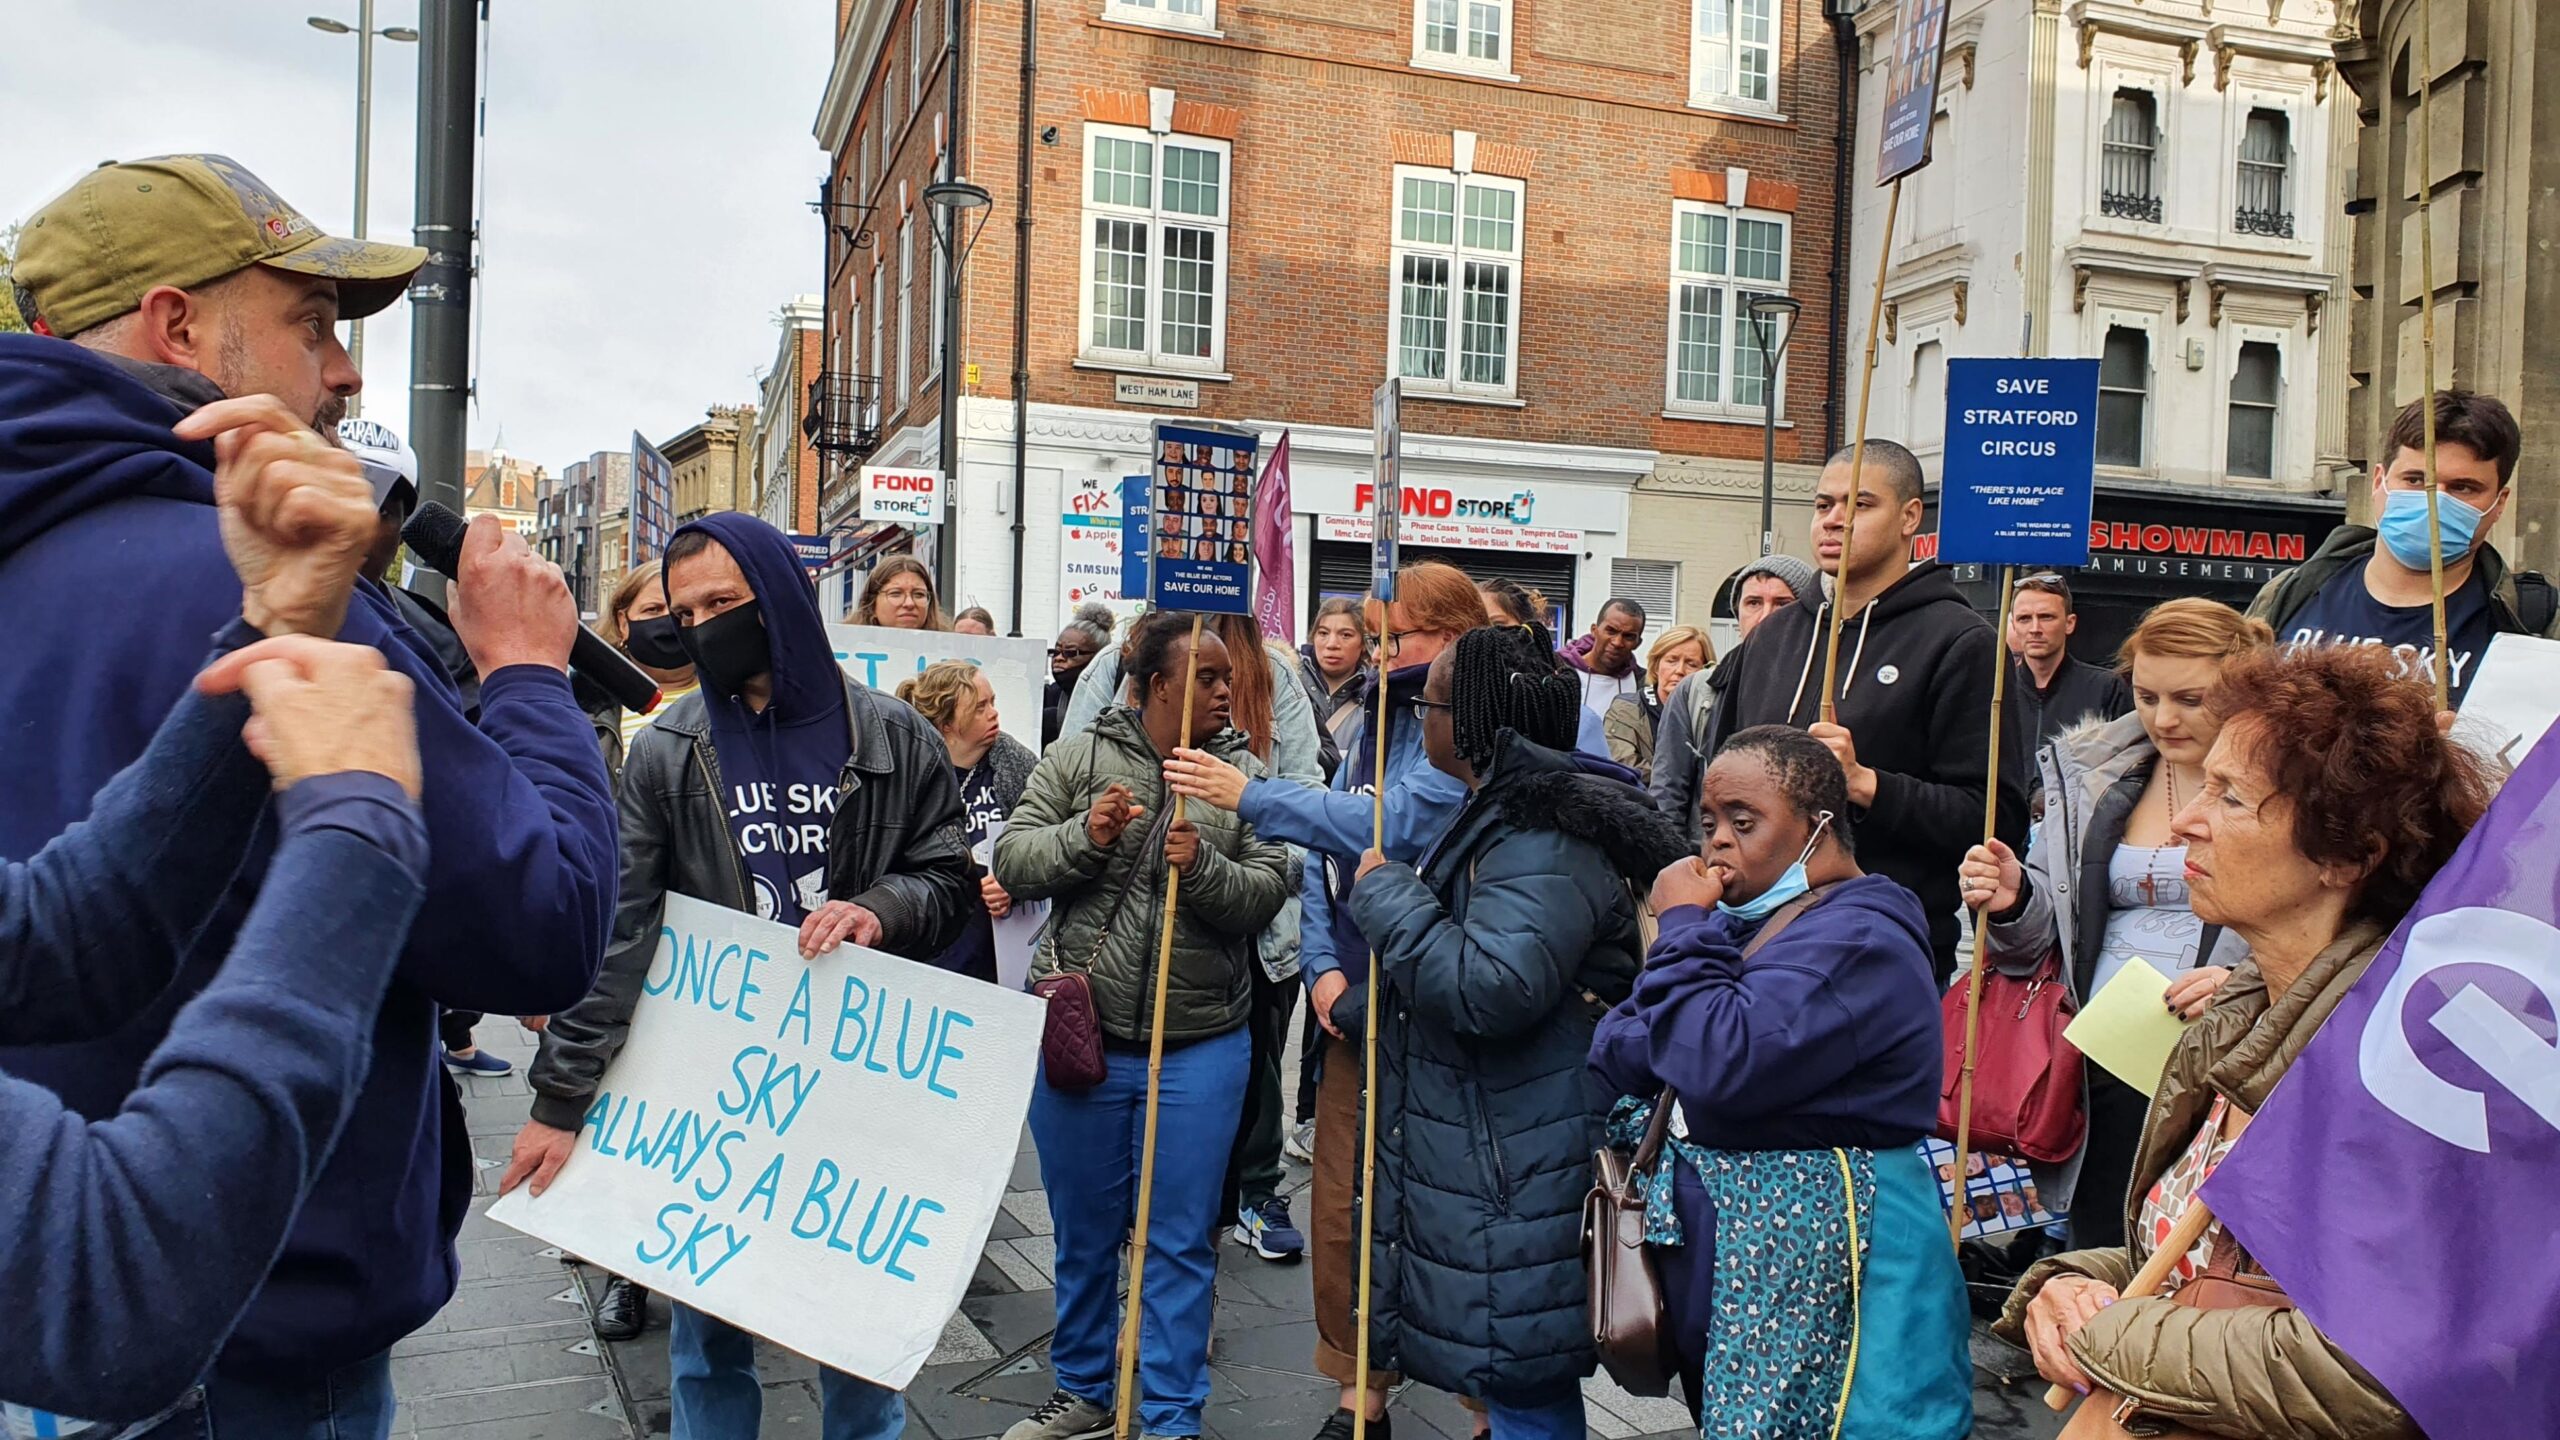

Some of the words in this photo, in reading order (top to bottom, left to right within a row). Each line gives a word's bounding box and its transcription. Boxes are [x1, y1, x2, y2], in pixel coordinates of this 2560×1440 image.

[1120, 384, 1144, 396] WEST
[1148, 386, 1167, 397] HAM
[1171, 388, 1194, 400] LANE
[1996, 378, 2049, 394] SAVE
[1963, 410, 2078, 426] STRATFORD
[337, 420, 399, 451] CARAVAN
[1981, 440, 2056, 456] CIRCUS
[873, 474, 933, 492] FONO
[1082, 479, 1098, 488] WE
[2016, 486, 2031, 494] NO
[2032, 487, 2064, 496] PLACE
[874, 500, 916, 512] STORE
[1354, 484, 1452, 518] FNO
[1456, 498, 1515, 520] STORE
[1988, 497, 2010, 505] LIKE
[1085, 530, 1118, 541] Apple
[1326, 516, 1355, 527] Gaming
[1411, 522, 1434, 530] Phone
[1436, 524, 1459, 532] Cases
[1466, 525, 1488, 534] Tablet
[1491, 527, 1514, 536] Cases
[1520, 528, 1556, 539] Tempered
[1558, 530, 1578, 540] Glass
[1420, 534, 1439, 543] Data
[1441, 536, 1462, 544] Cable
[1468, 537, 1489, 546] Selfie
[1491, 538, 1509, 547] Stick
[1516, 540, 1540, 550] AirPod
[1546, 542, 1569, 552] Tripod
[2089, 520, 2305, 561] SHOWMAN
[1212, 574, 1232, 582] ACTORS
[1082, 582, 1098, 596] LG
[1164, 582, 1190, 592] SAVE
[1192, 584, 1213, 594] OUR
[1214, 585, 1240, 596] HOME
[644, 926, 770, 1022] ONCE
[778, 967, 810, 1045] A
[831, 975, 974, 1099] BLUE
[718, 1045, 820, 1136] SKY
[584, 1091, 746, 1202] ALWAYS
[738, 1152, 784, 1222] A
[791, 1158, 946, 1282] BLUE
[636, 1202, 751, 1287] SKY
